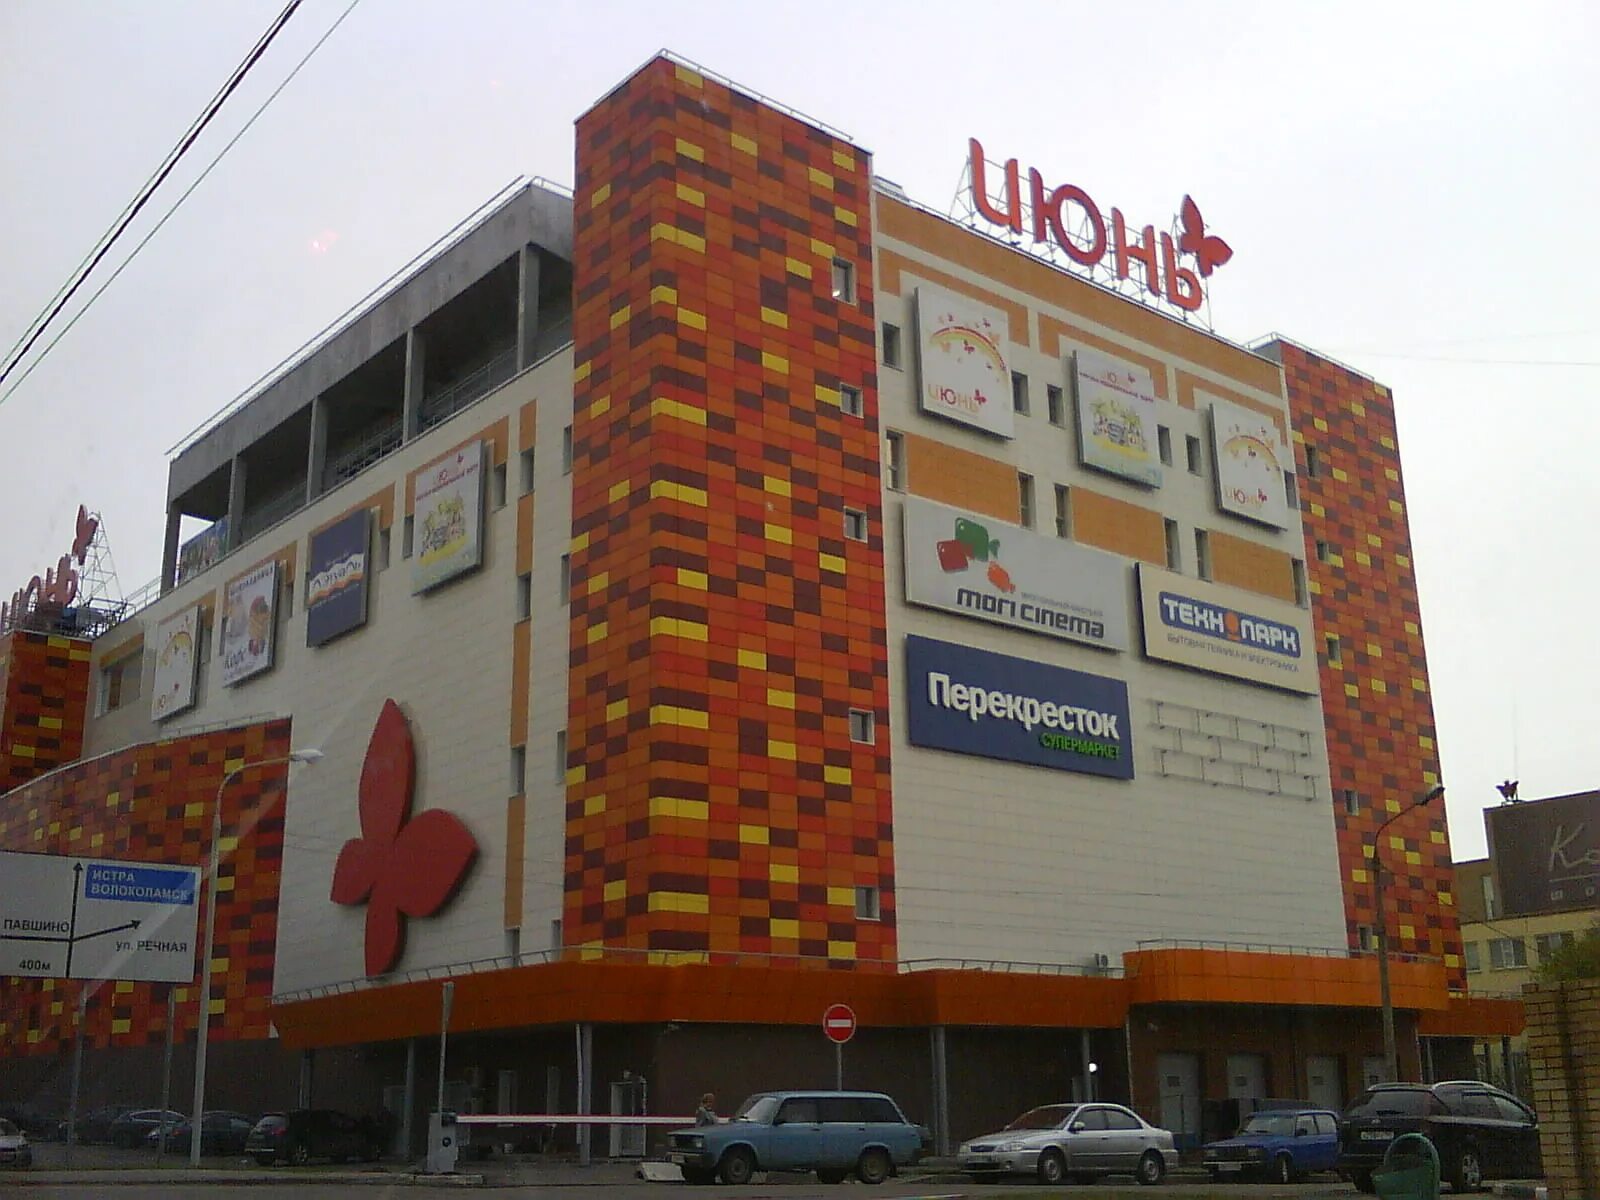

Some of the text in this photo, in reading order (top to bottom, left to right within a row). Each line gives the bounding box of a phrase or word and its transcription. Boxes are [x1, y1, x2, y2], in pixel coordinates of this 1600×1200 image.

[969, 137, 1203, 312] ИЮНЬ
[957, 588, 1017, 618] mori
[1021, 603, 1104, 639] cinema
[928, 672, 1120, 740] Перекресток
[1039, 733, 1120, 759] СУПЕРМАРКЕТ
[91, 869, 135, 882] ИСТРА
[91, 884, 190, 901] ВОЛОКОЛАМСК
[4, 919, 70, 932] ПАВШИНО
[116, 940, 187, 952] ул. РЕЧНАЯ
[19, 960, 50, 970] 400м
